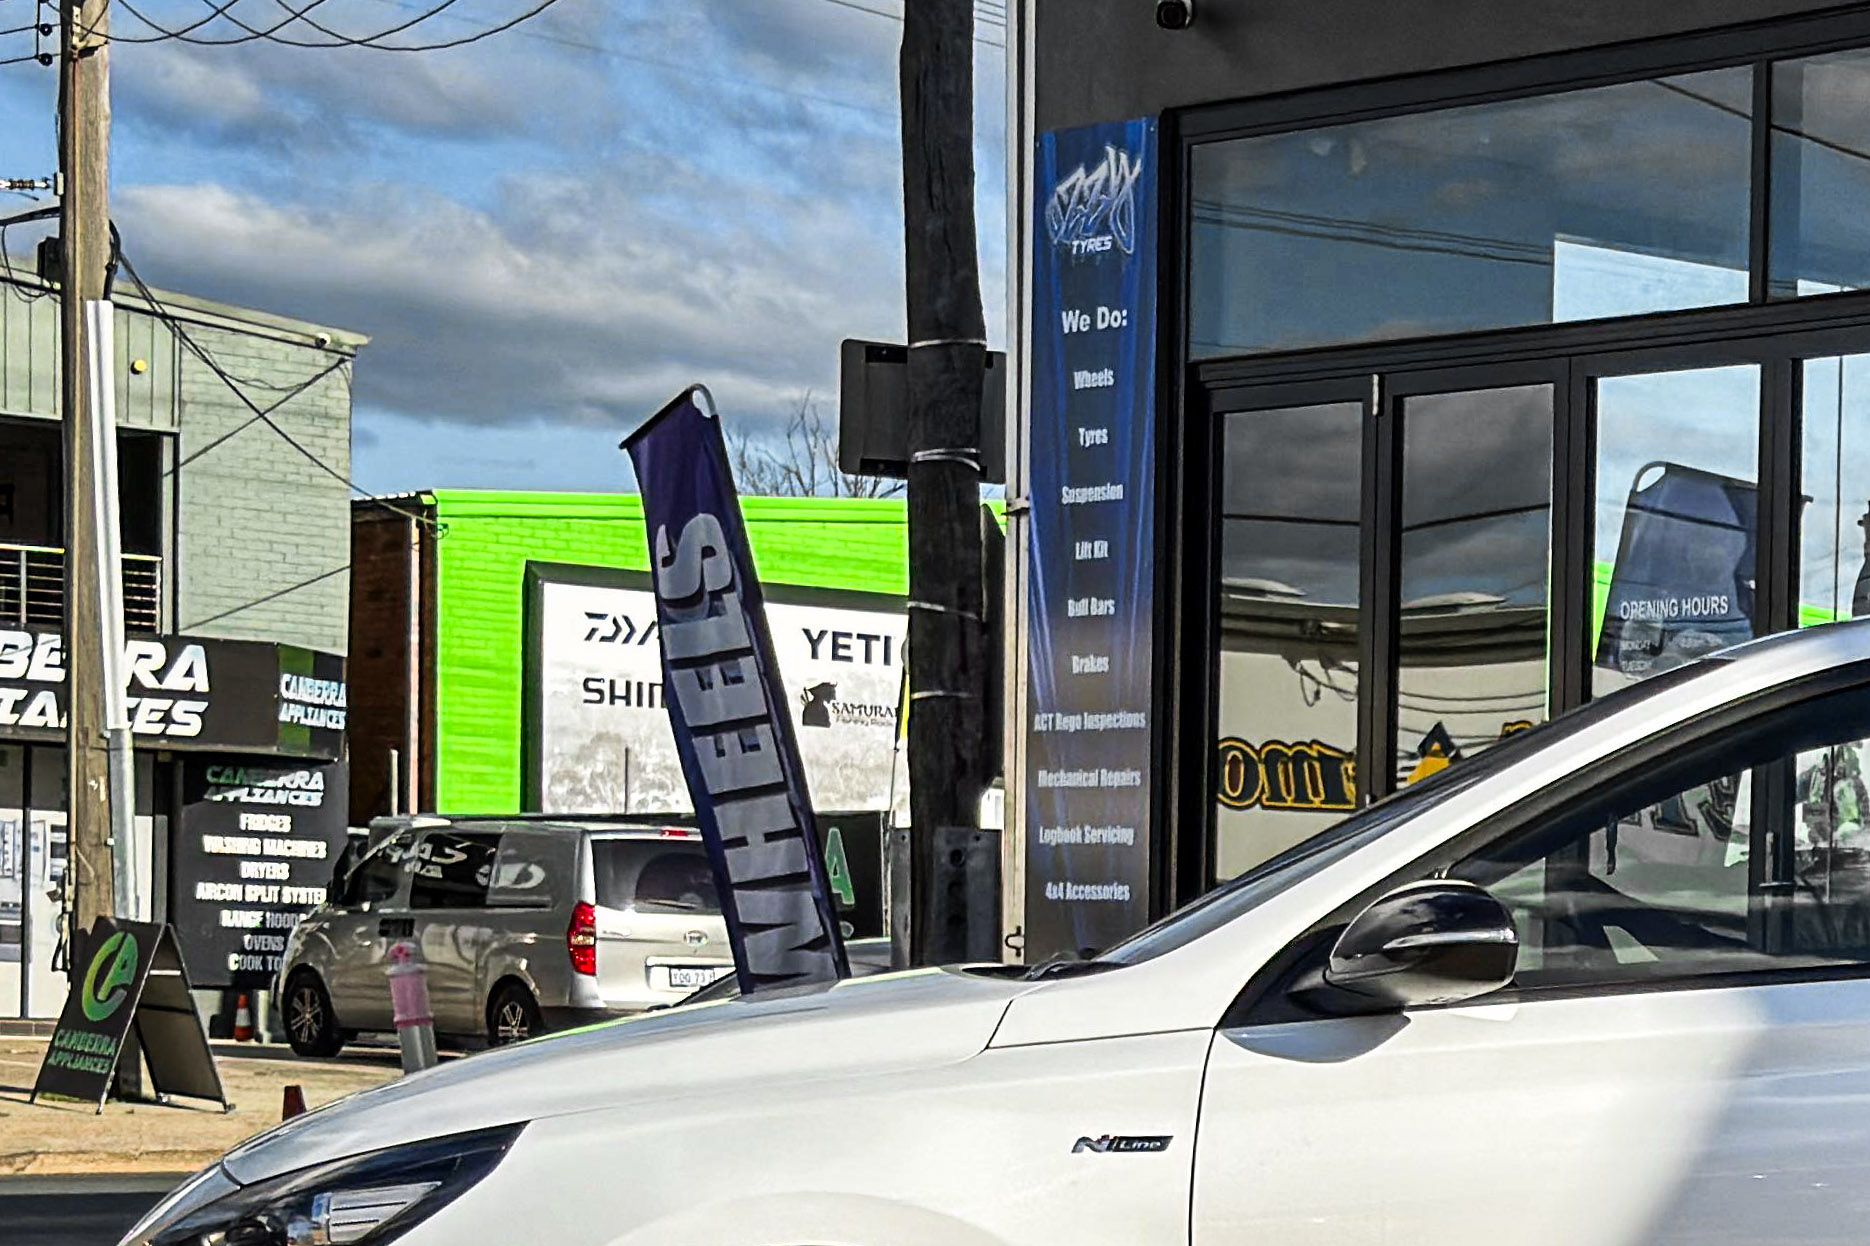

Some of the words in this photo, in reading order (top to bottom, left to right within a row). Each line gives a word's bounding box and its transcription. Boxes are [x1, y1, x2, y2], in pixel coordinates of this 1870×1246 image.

[1071, 236, 1113, 255] TYRES
[1062, 309, 1091, 334] We
[1097, 306, 1128, 330] Do:
[1074, 368, 1114, 389] Wheels
[1078, 427, 1108, 447] Tyres
[1061, 482, 1123, 505] Suspension
[1075, 541, 1092, 560] Lift
[1093, 540, 1109, 558] Kit
[1068, 598, 1089, 617] Bull
[1090, 597, 1116, 616] Bars
[1620, 600, 1679, 621] OPENING
[1682, 596, 1729, 616] HOURS
[801, 627, 893, 667] YETI
[0, 630, 210, 693] BERA
[1072, 653, 1110, 674] Brakes
[280, 673, 347, 708] CANBERRA
[279, 702, 347, 730] APPLIANCES
[1034, 713, 1054, 731] ACT
[1055, 713, 1082, 733] Rego
[1084, 711, 1146, 732] Inspections
[656, 513, 838, 990] WHEELS
[1038, 769, 1099, 788] Mechanical
[1100, 768, 1141, 788] Repairs
[239, 813, 292, 833] FRIDGES
[1039, 826, 1082, 846] Logbook
[1084, 825, 1134, 846] Servicing
[203, 834, 262, 855] WASHING
[263, 838, 327, 859] MACHINES
[240, 861, 290, 880] DRYERS
[196, 882, 243, 901] AIRCON
[244, 884, 280, 903] SPLIT
[281, 886, 327, 905] SYSTE
[1045, 882, 1064, 900] 4x4
[1065, 882, 1131, 900] Accessories
[221, 909, 264, 929] RANGE
[243, 933, 285, 951] OVENS
[228, 953, 263, 971] COOK
[266, 955, 284, 971] TO
[54, 1028, 118, 1056] CANBERRA
[47, 1050, 112, 1075] APPLIANCES
